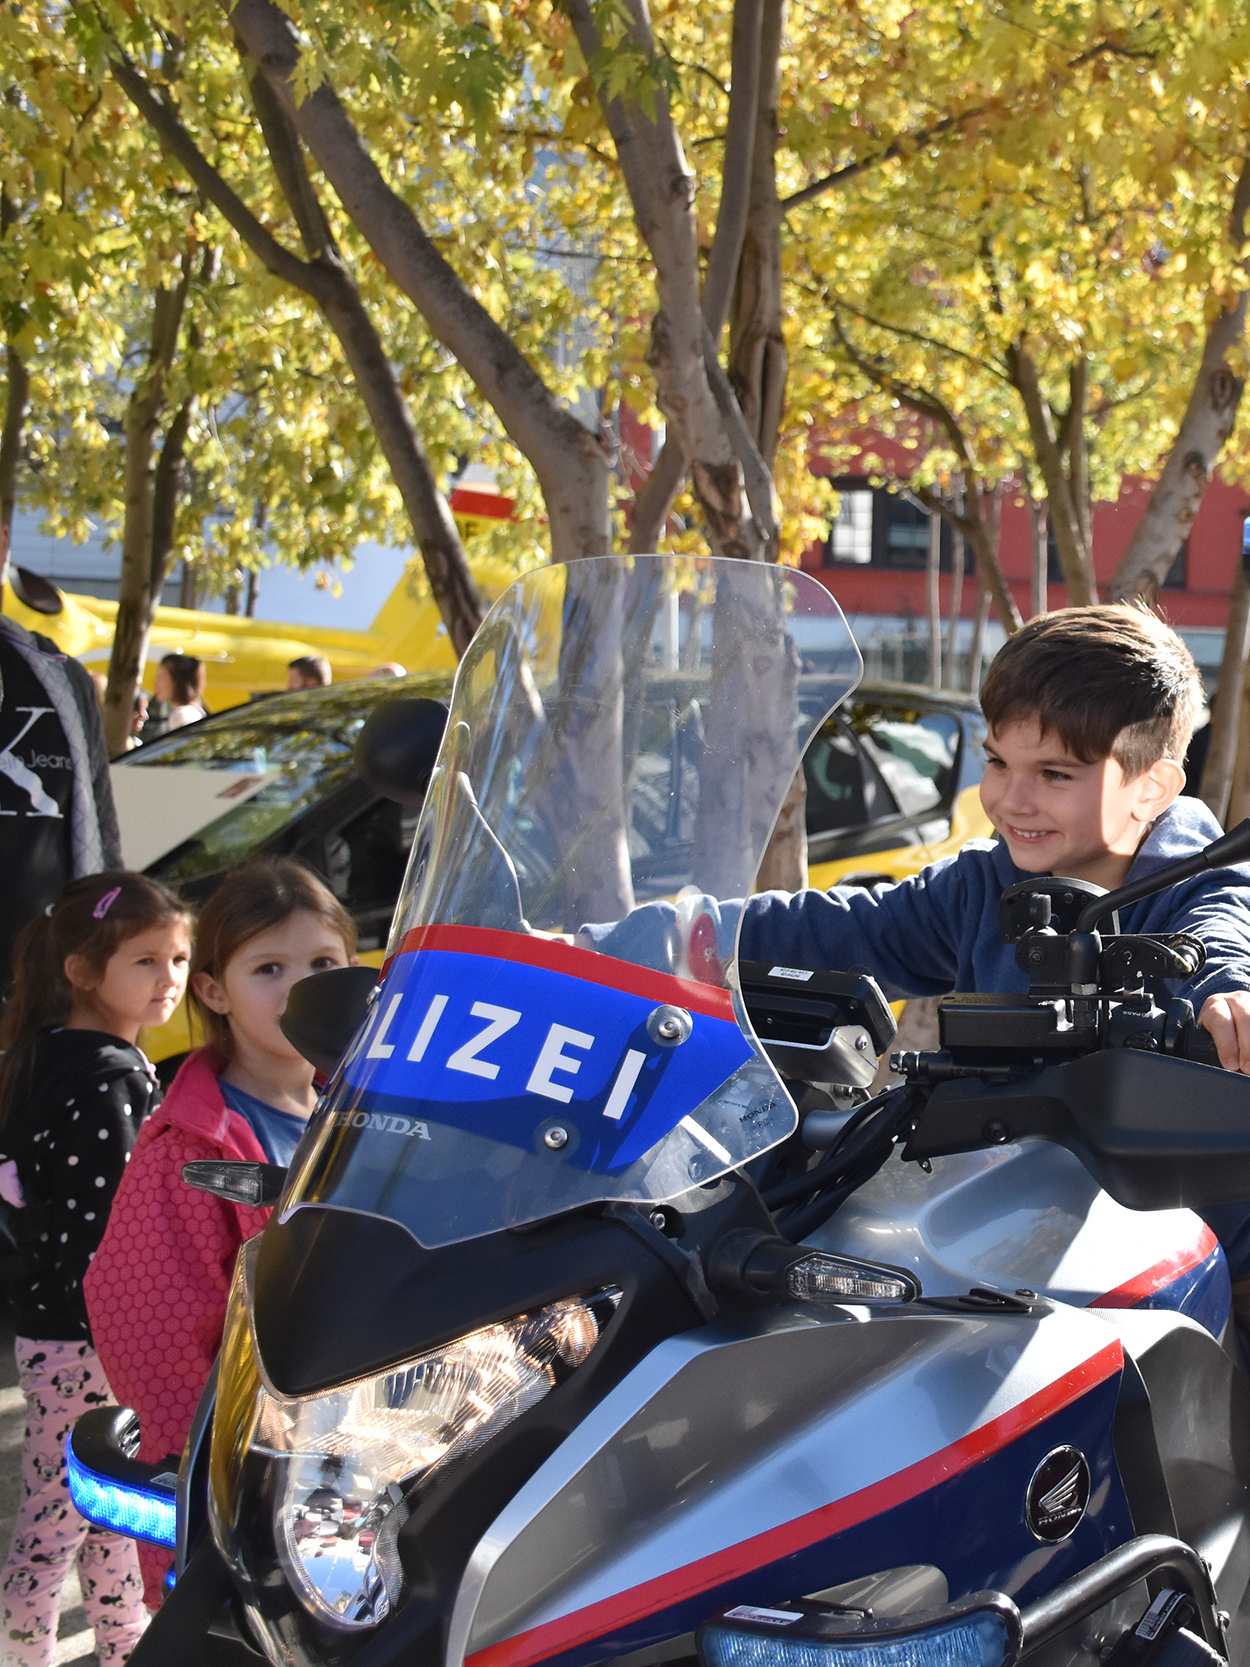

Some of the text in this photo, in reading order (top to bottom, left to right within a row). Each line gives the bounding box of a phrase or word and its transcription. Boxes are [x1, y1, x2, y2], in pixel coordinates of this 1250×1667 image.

[330, 993, 647, 1120] OLIZEI
[739, 1102, 777, 1123] HONDA
[335, 1111, 432, 1140] HONDA
[1038, 1504, 1082, 1526] HONDA
